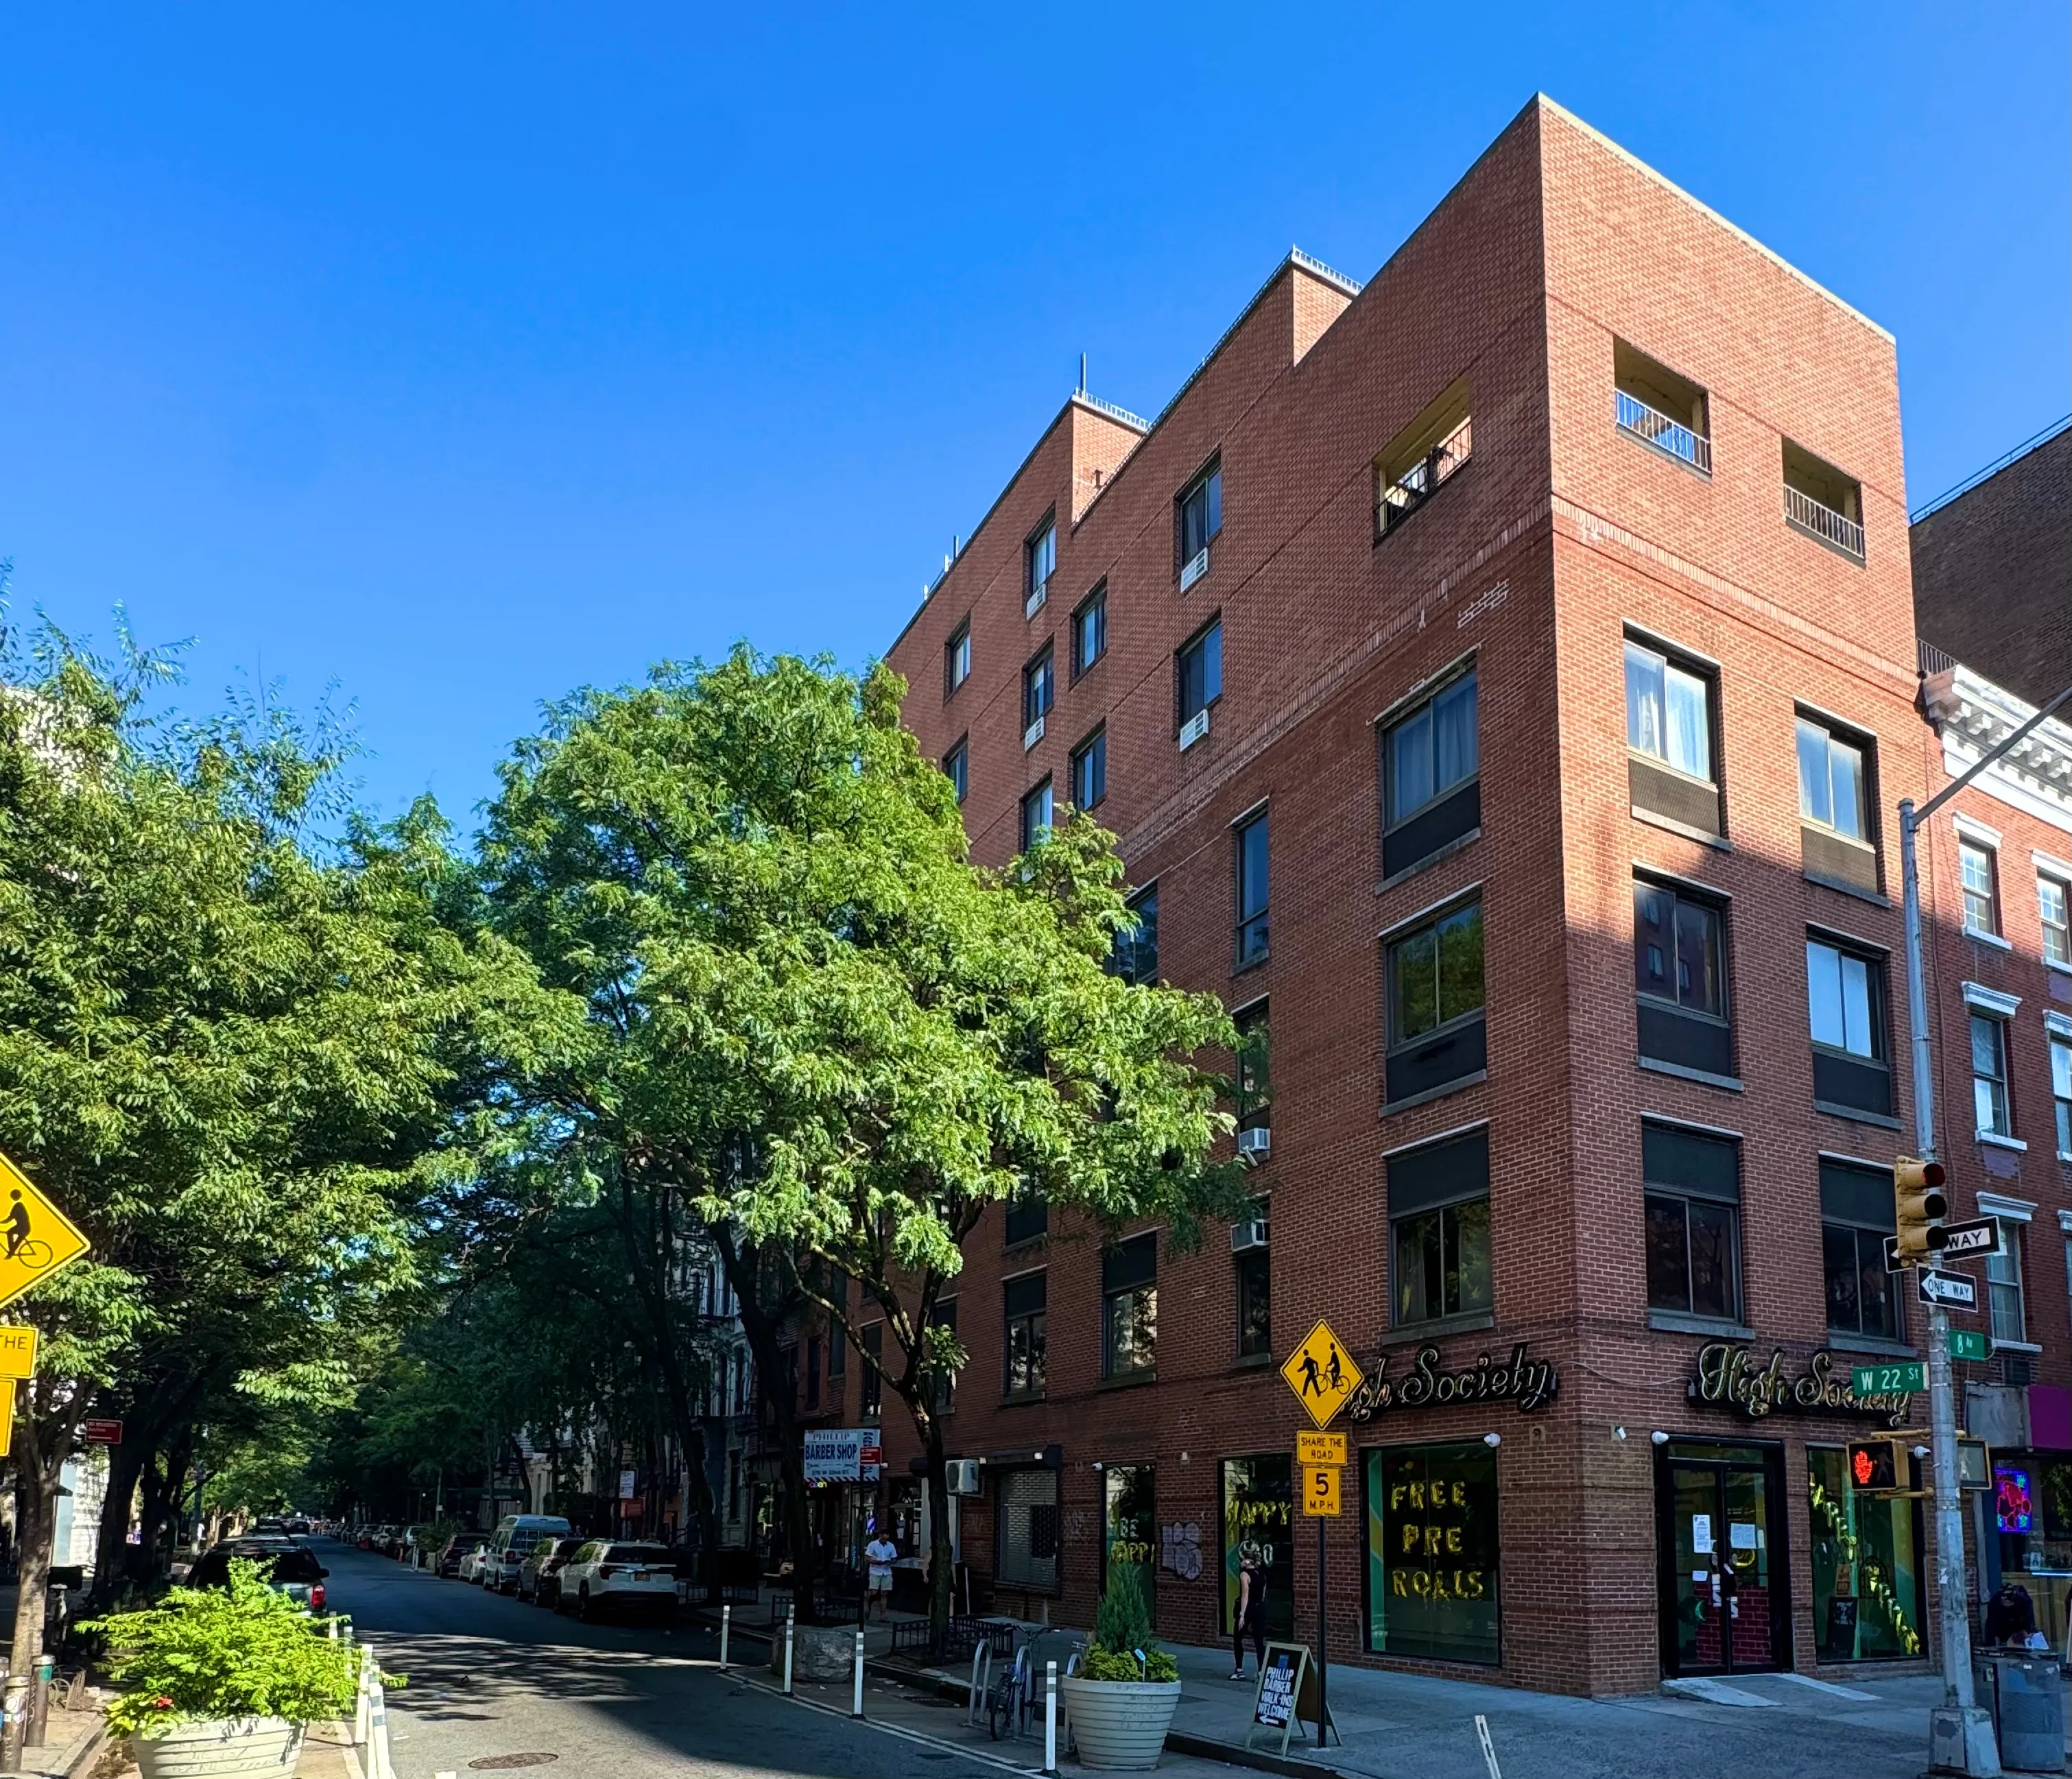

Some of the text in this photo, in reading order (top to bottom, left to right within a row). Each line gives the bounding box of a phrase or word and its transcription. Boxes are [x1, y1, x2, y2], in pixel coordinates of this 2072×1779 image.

[1946, 1231, 1982, 1250] WAY
[1928, 1278, 1970, 1299] ONE WAY
[1957, 1335, 1963, 1354] 8
[1401, 1348, 1547, 1409] Society
[1700, 1343, 1787, 1416] High
[1861, 1367, 1919, 1391] W 22 St
[805, 1443, 857, 1460] BARBER SHOP
[1300, 1437, 1343, 1448] SHARE THE
[1311, 1449, 1333, 1459] ROAD
[1315, 1472, 1329, 1496] 5
[1390, 1480, 1466, 1512] FREE
[1227, 1501, 1291, 1525] HAPPY
[1403, 1524, 1463, 1556] PRE
[1392, 1570, 1484, 1601] ROLLS
[1265, 1667, 1294, 1681] PHILLIP
[1263, 1677, 1291, 1694] BARBER
[1257, 1702, 1291, 1720] WELCOME
